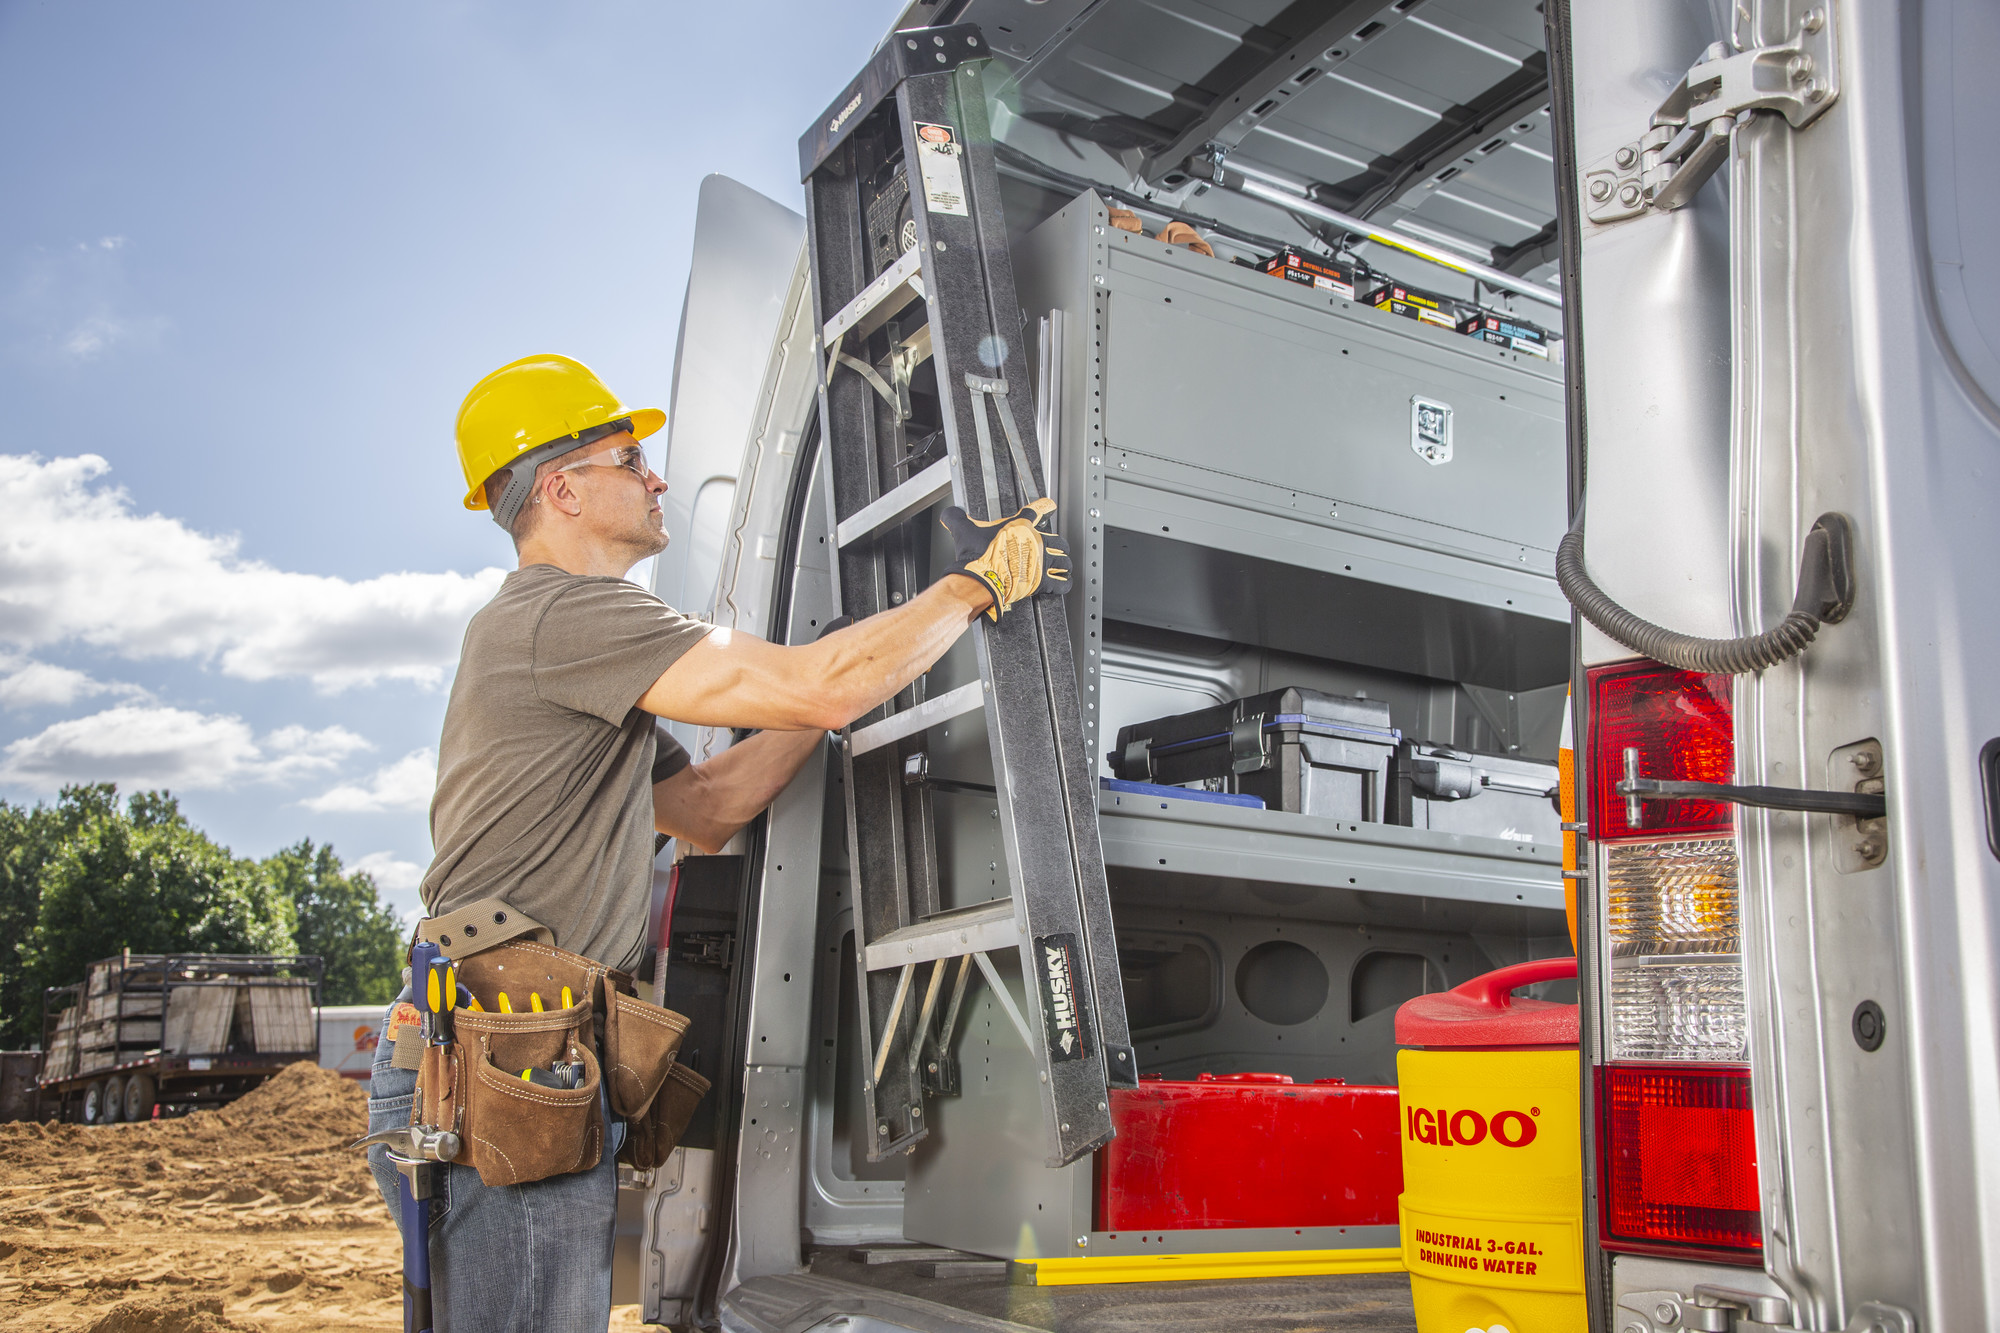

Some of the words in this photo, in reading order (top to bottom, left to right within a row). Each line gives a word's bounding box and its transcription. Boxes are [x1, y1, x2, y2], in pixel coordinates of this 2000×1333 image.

[1303, 262, 1322, 272] DRYWALL
[1323, 267, 1340, 278] SCREWS
[1045, 946, 1072, 1030] HUSKY
[1416, 1228, 1482, 1251] INDUSTRIAL
[1487, 1239, 1543, 1256] 3-GAL.
[1420, 1248, 1478, 1270] DRINKING
[1483, 1258, 1537, 1276] WATER
